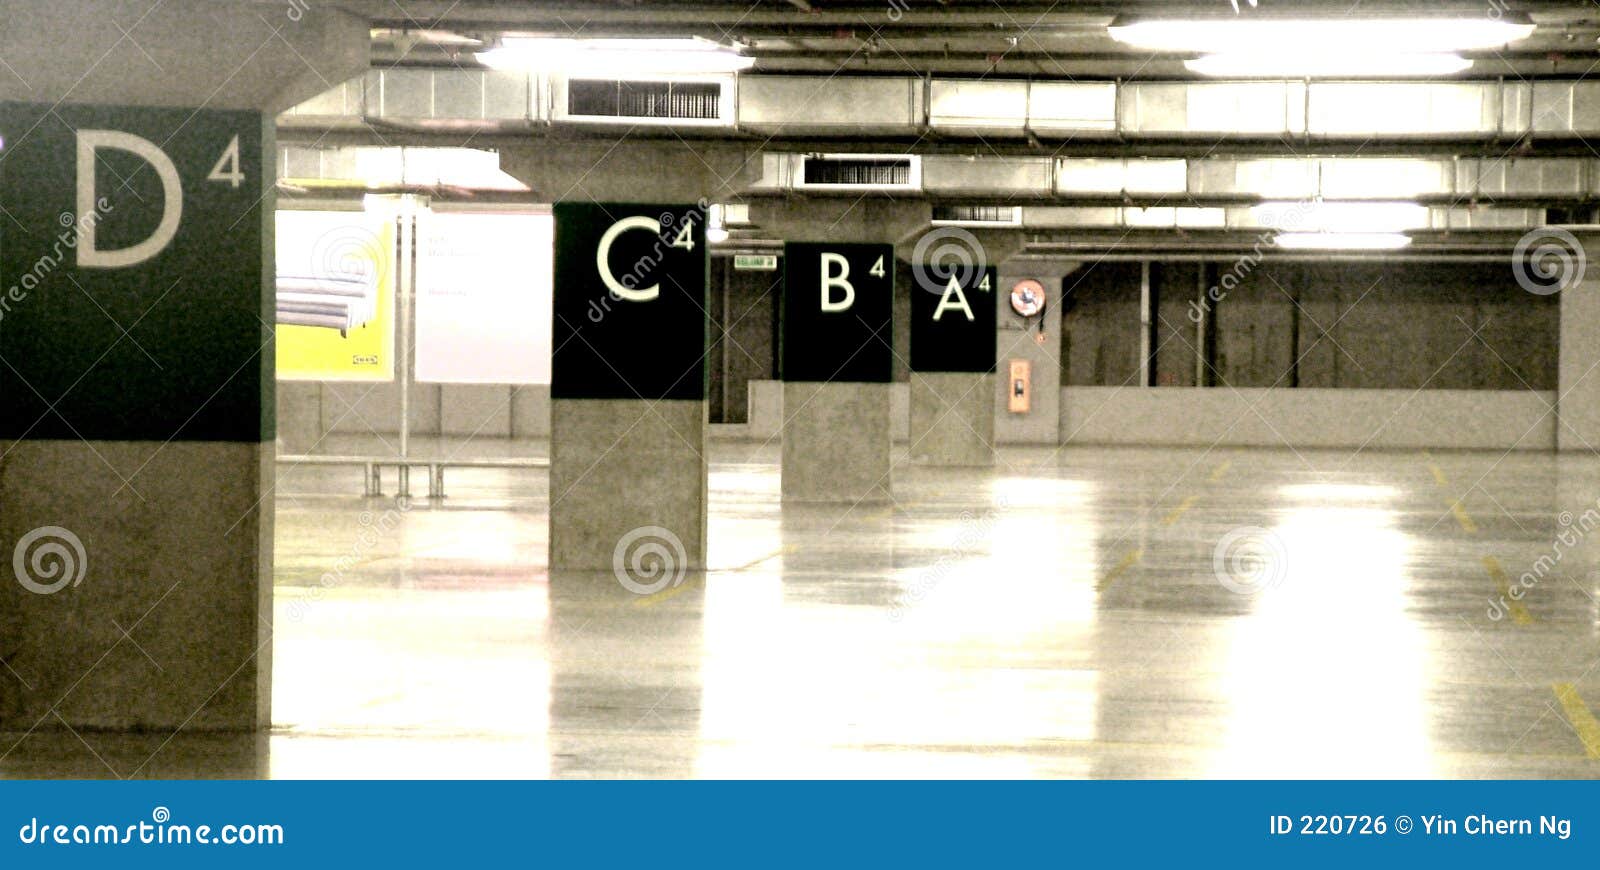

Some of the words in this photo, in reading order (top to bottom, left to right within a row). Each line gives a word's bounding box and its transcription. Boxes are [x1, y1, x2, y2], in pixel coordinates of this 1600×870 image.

[76, 129, 183, 268] D
[207, 135, 246, 188] 4
[597, 215, 661, 302] C
[673, 219, 696, 252] 4
[820, 252, 855, 312] B
[868, 255, 885, 279] 4
[932, 273, 975, 321] A
[978, 273, 991, 293] 4
